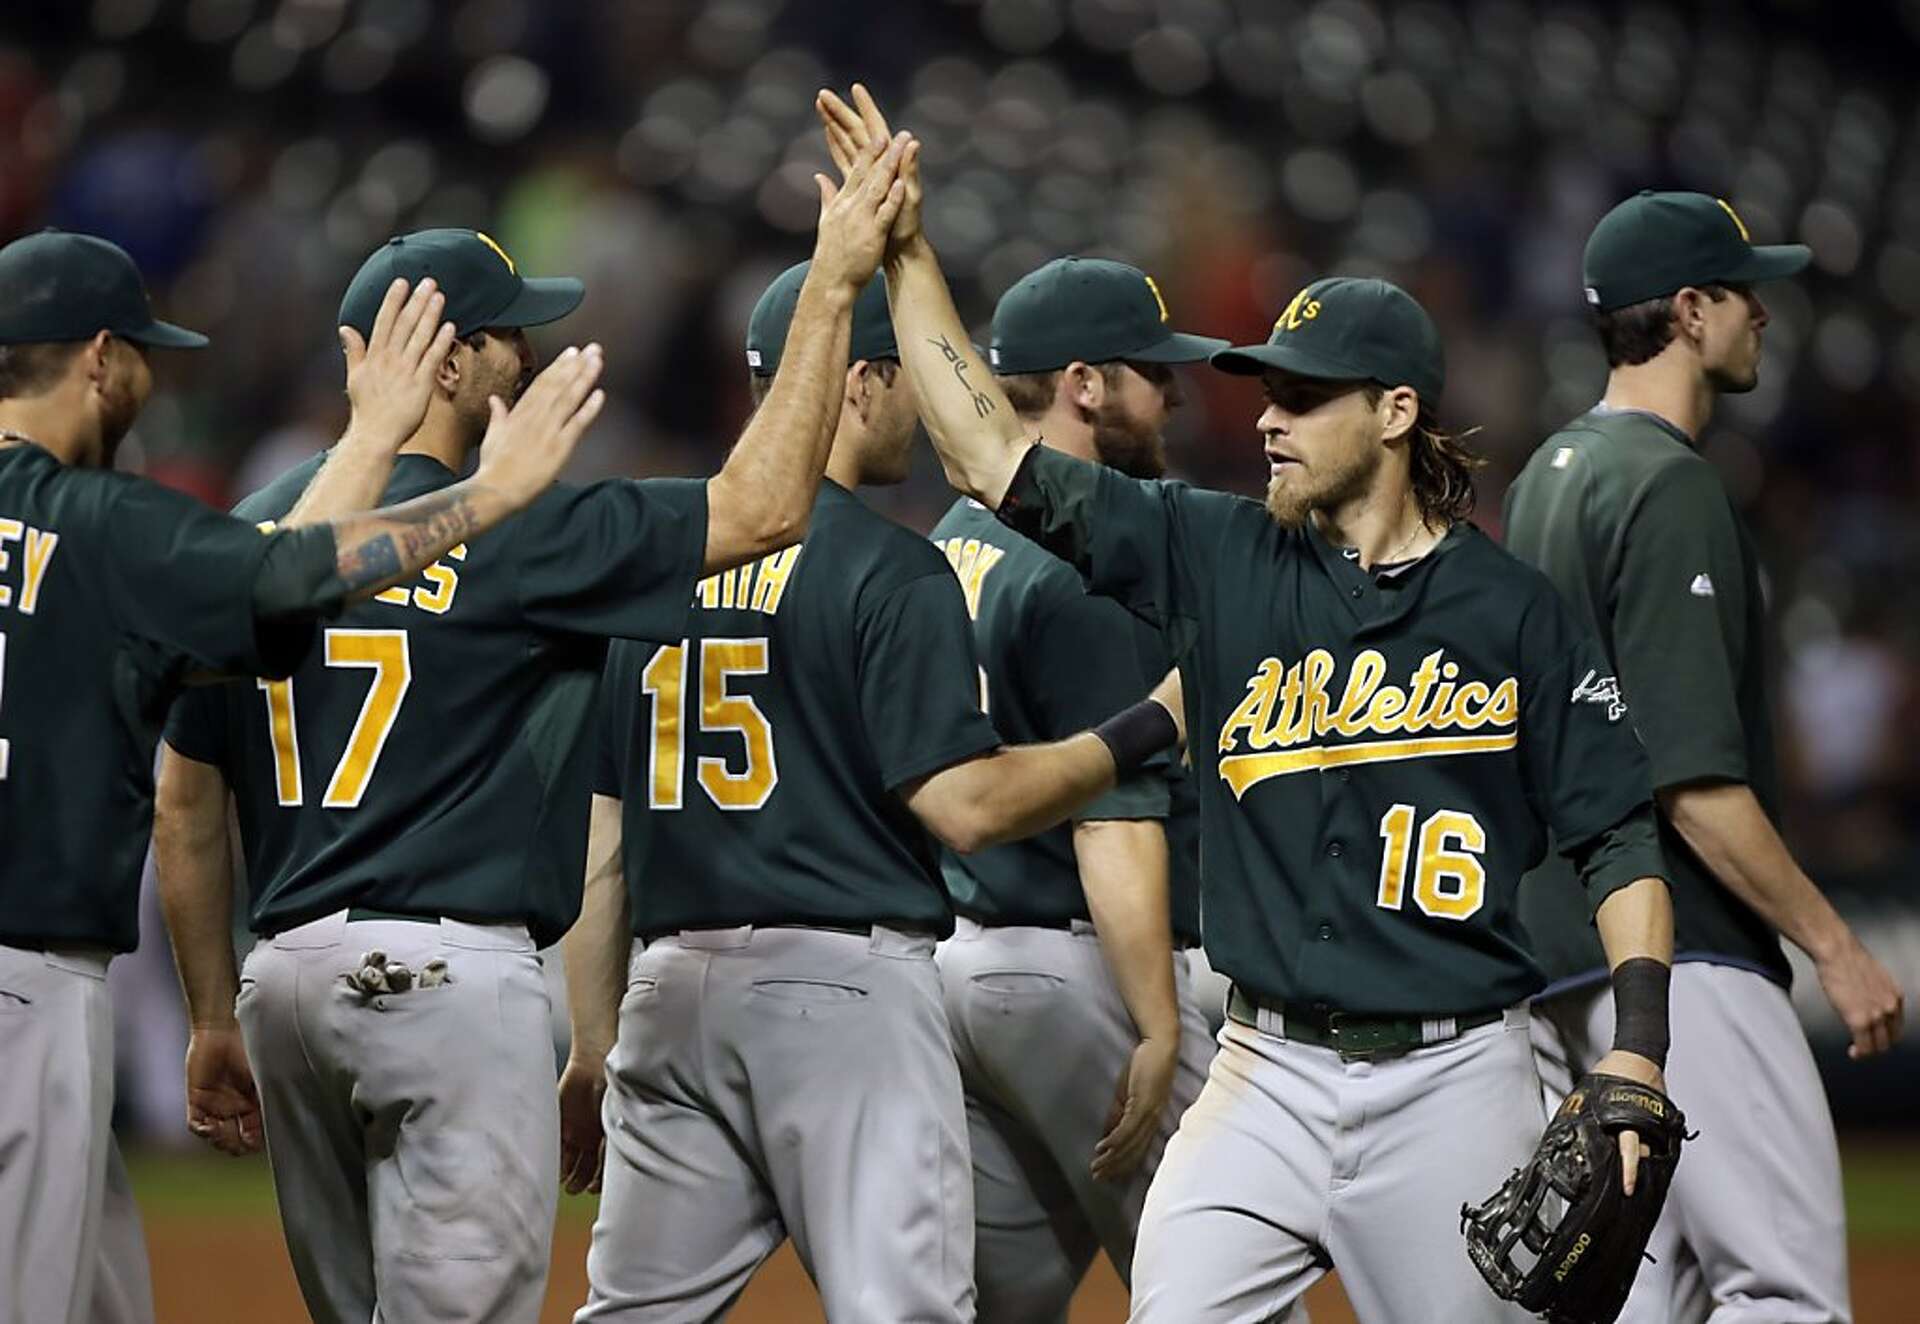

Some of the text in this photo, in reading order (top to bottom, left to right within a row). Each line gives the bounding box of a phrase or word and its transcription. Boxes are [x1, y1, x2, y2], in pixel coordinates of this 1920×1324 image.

[257, 628, 412, 809] 17
[642, 637, 778, 811] 15
[1218, 648, 1519, 753] Athletics
[1377, 803, 1487, 922] 16
